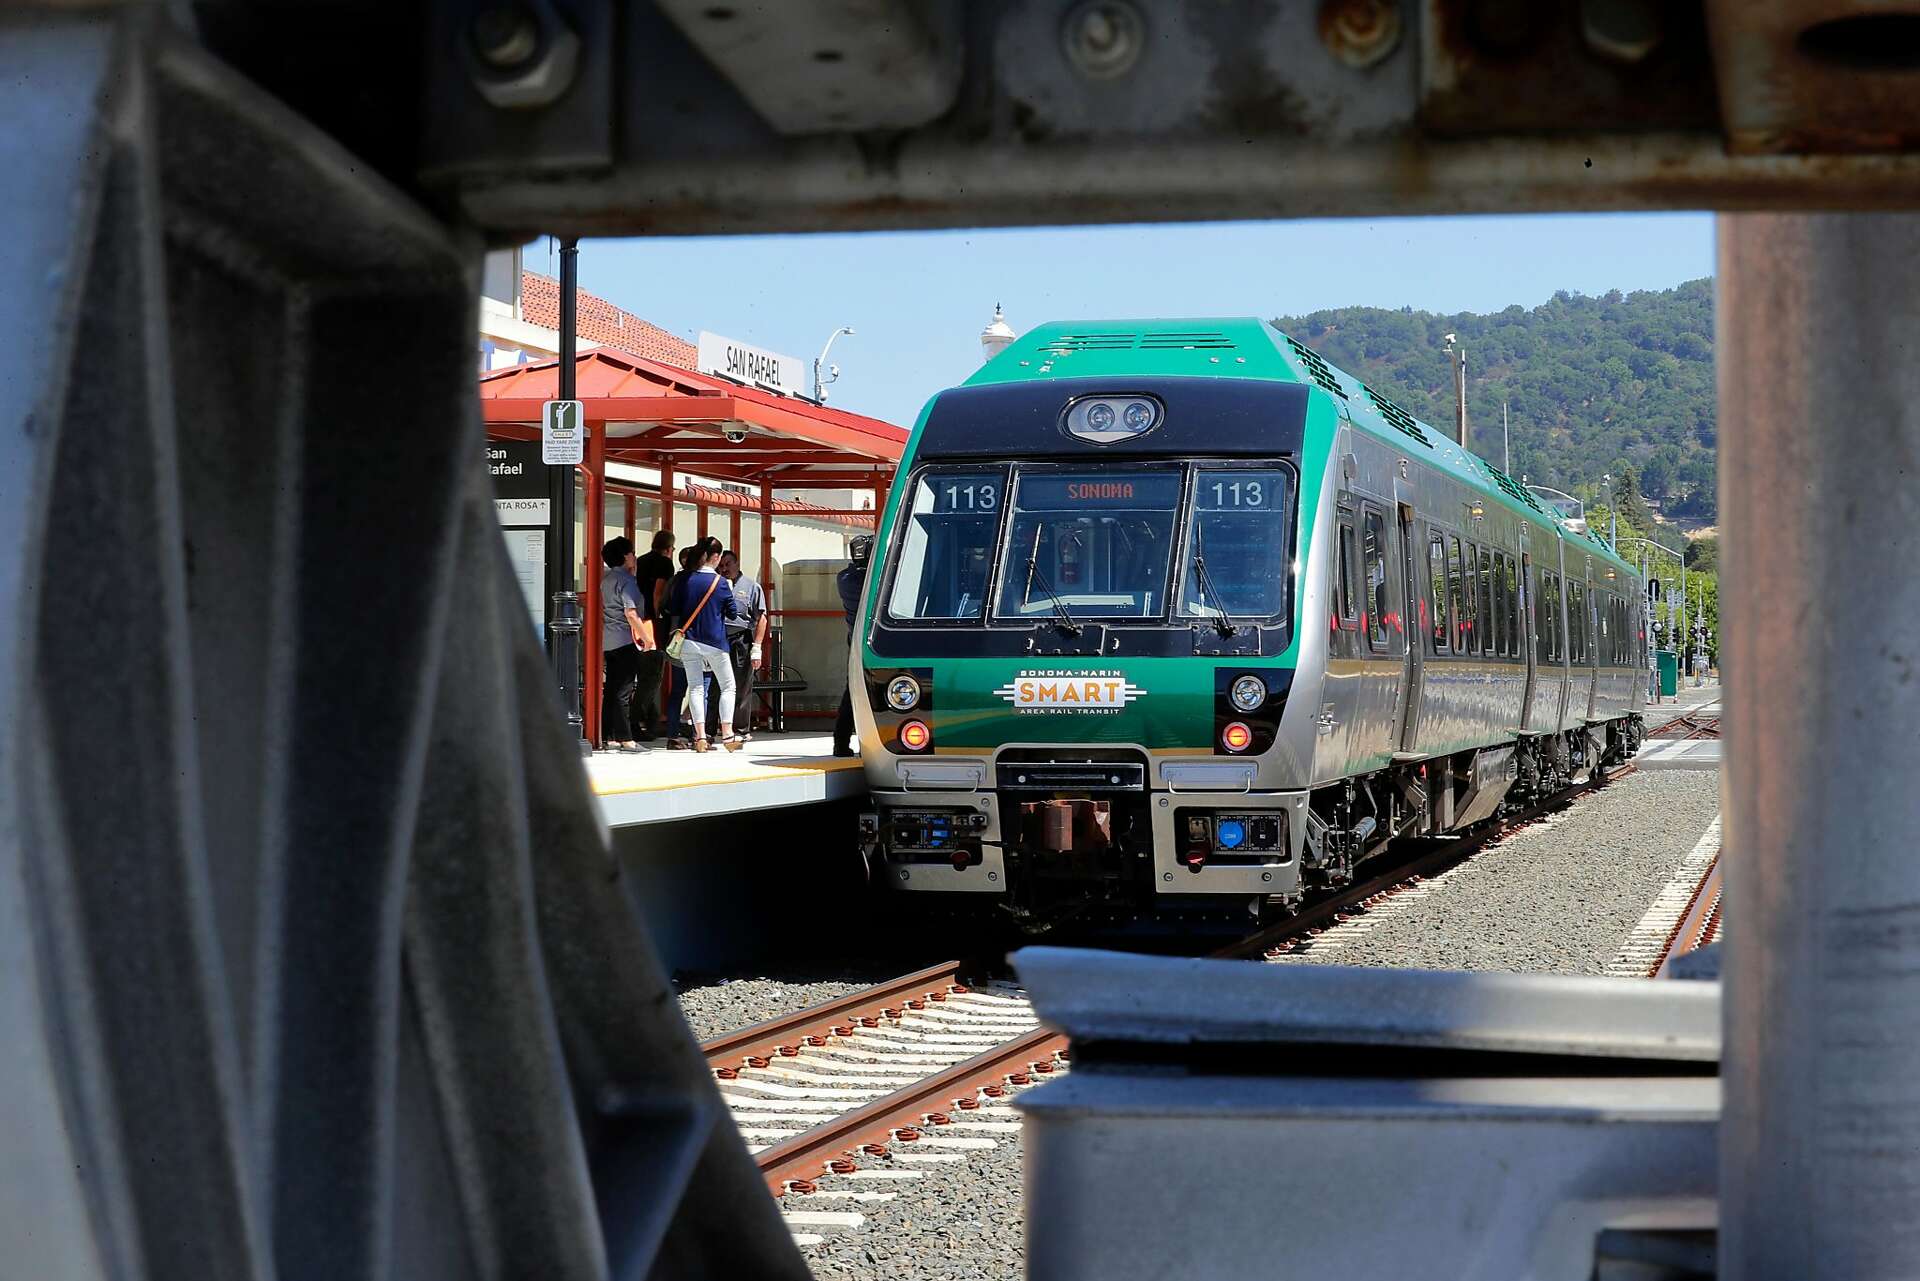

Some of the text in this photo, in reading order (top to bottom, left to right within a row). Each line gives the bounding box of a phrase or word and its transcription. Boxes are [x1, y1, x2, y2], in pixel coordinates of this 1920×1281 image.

[726, 345, 781, 386] SAN RAFAEL
[485, 447, 507, 459] San
[945, 485, 996, 509] 113
[1068, 483, 1134, 499] SONOMA
[1212, 482, 1262, 506] 113
[495, 501, 538, 510] NTA ROSA
[1020, 682, 1120, 703] SMART
